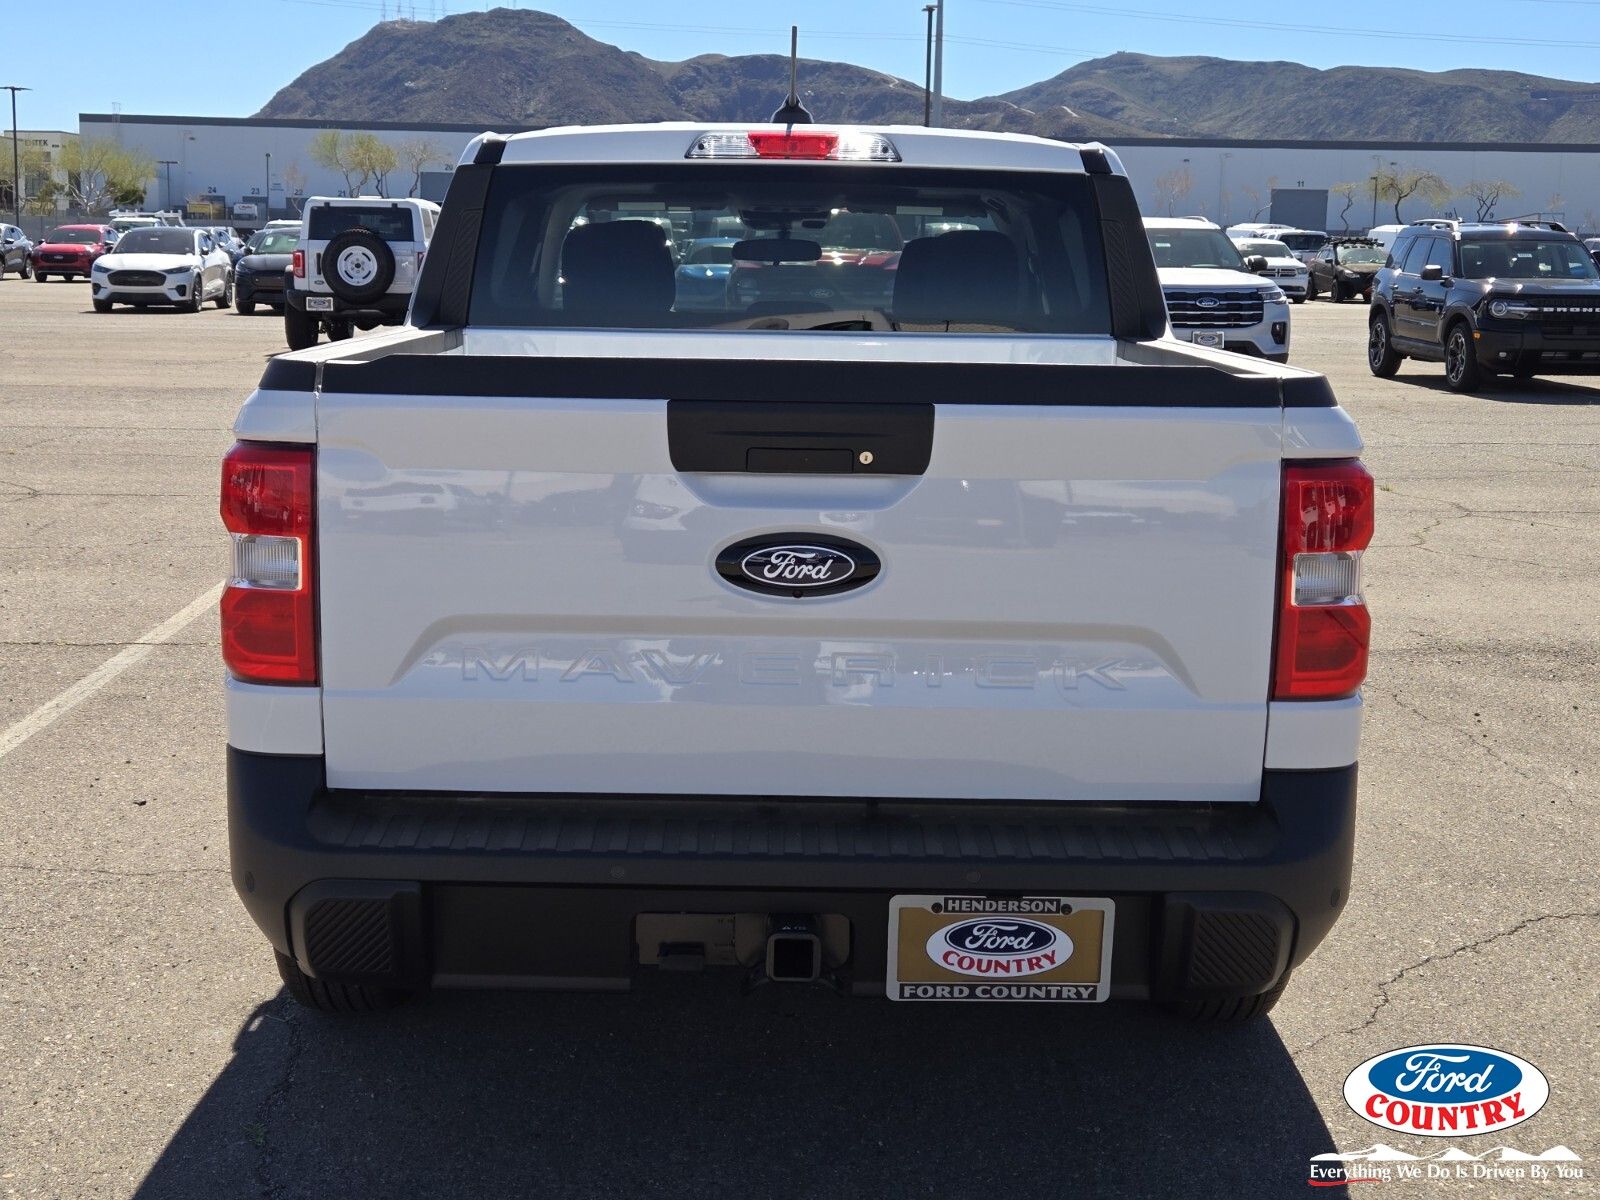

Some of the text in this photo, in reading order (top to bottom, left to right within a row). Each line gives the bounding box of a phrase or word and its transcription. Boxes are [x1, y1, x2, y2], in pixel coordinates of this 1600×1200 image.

[251, 187, 260, 195] 23
[763, 551, 834, 579] Ford
[461, 649, 1128, 691] MAVERICK
[948, 899, 1057, 912] HENDERSON
[965, 923, 1036, 950] Ford
[942, 950, 1057, 974] COUNTRY
[903, 985, 1095, 1000] FORD COUNTRY
